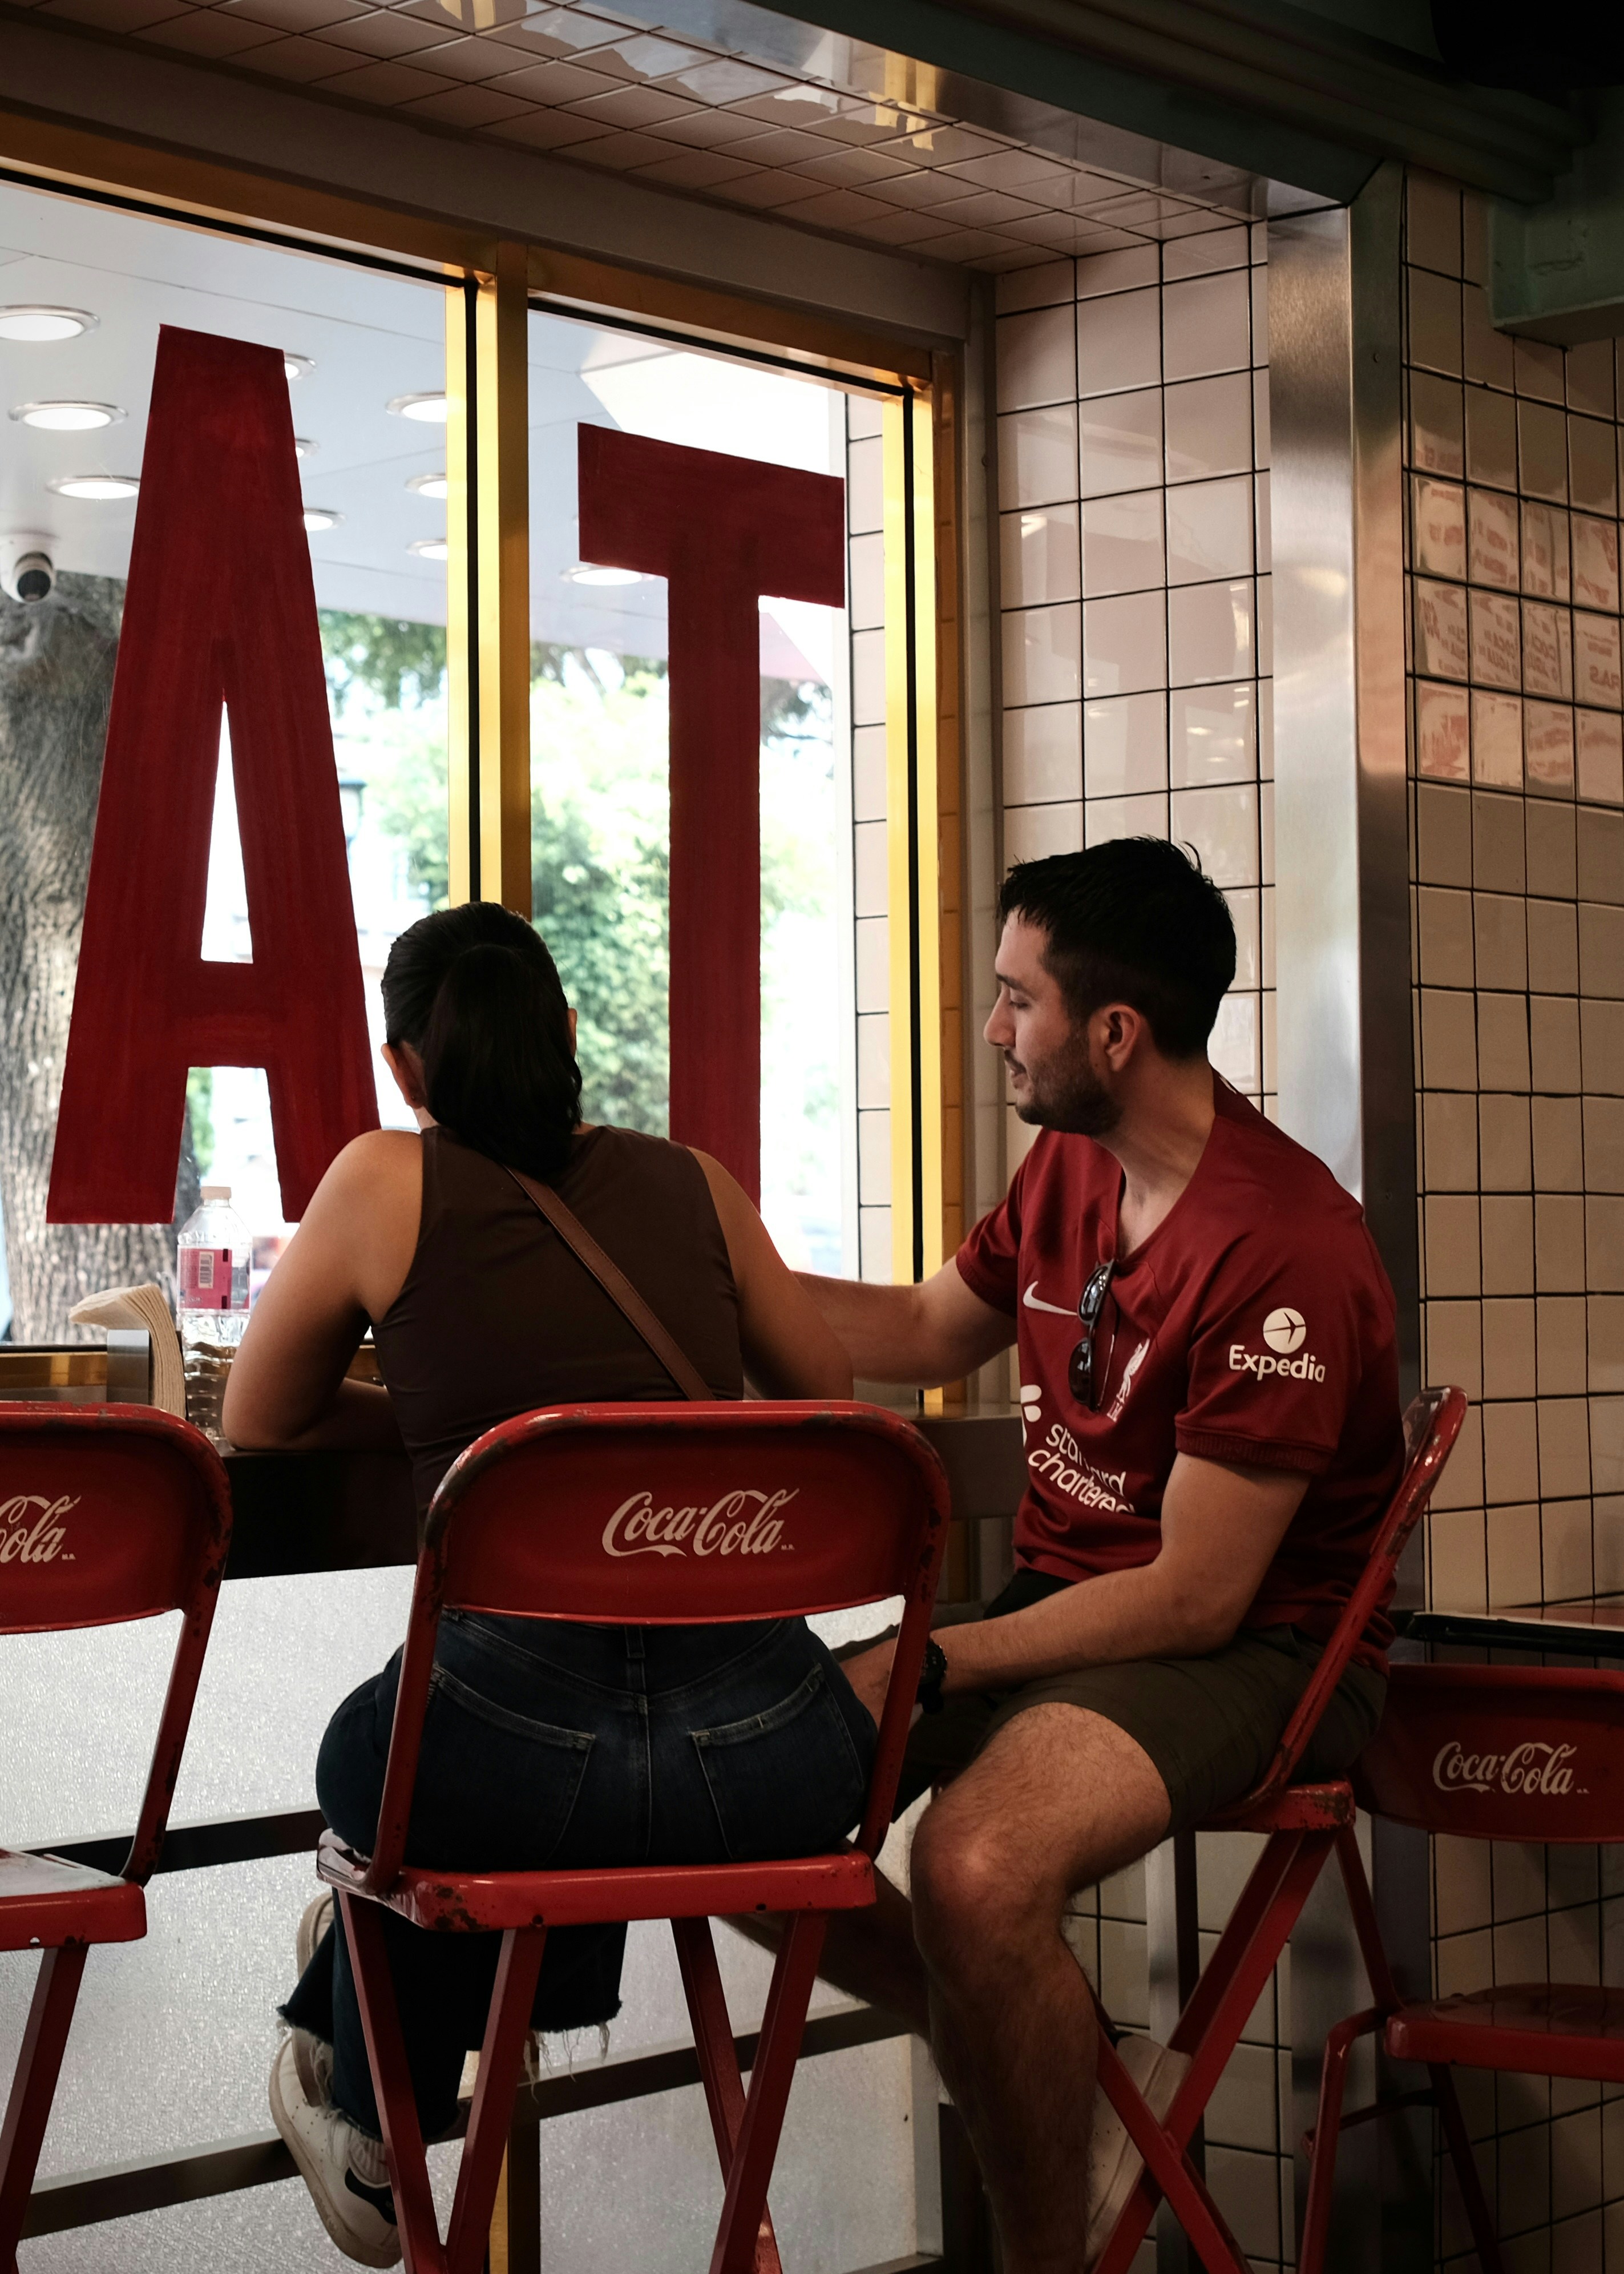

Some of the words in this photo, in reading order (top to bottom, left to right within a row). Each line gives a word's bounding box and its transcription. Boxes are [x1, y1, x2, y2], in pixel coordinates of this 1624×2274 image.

[1230, 1345, 1326, 1382] Expedia
[602, 1488, 800, 1558] Coca-Cola
[1432, 1741, 1577, 1795] Coca-Cola
